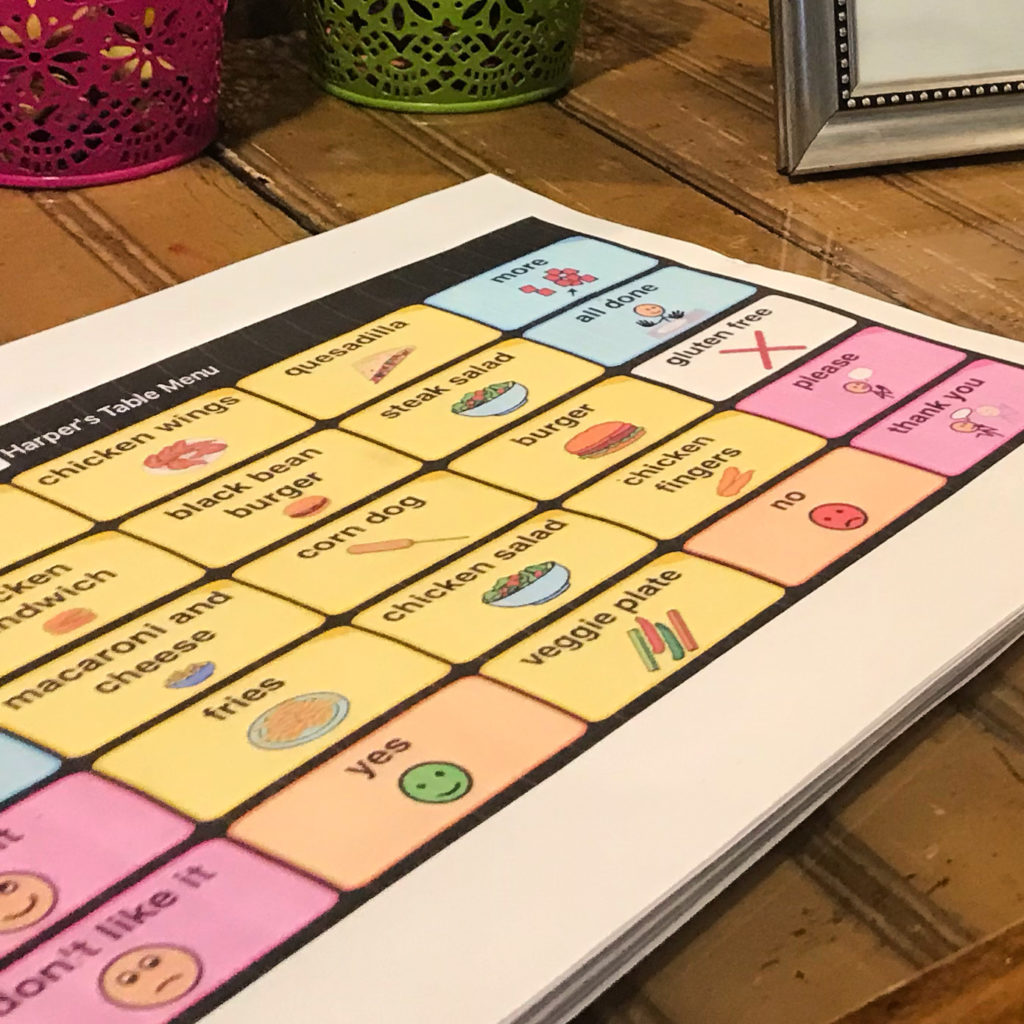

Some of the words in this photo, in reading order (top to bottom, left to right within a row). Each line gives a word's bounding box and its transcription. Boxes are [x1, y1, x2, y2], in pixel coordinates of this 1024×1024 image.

[491, 257, 550, 284] more
[576, 307, 606, 323] all
[605, 283, 659, 310] done
[284, 318, 410, 378] quesadilla
[666, 329, 734, 368] gluten
[727, 307, 773, 330] free
[380, 383, 451, 420] steak
[449, 352, 516, 387] salad
[792, 352, 860, 391] please
[1, 412, 101, 459] Harper's
[97, 389, 160, 417] Table
[157, 365, 221, 394] Menu
[509, 403, 596, 447] burger
[887, 399, 951, 434] thank
[944, 377, 986, 402] you
[37, 432, 156, 487] chicken
[154, 395, 241, 432] wings
[623, 436, 716, 487] chicken
[655, 446, 743, 494] fingers
[164, 480, 254, 521] black
[248, 445, 325, 482] bean
[224, 469, 326, 519] burger
[769, 491, 807, 511] no
[296, 524, 367, 561] corn
[364, 493, 427, 529] dog
[382, 560, 496, 623] chicken
[493, 519, 569, 561] salad
[520, 612, 618, 666] veggie
[613, 569, 683, 613] plate
[3, 622, 169, 711] macaroni
[169, 590, 235, 625] and
[95, 629, 218, 694] cheese
[202, 674, 286, 721] fries
[345, 736, 412, 779] yes
[94, 890, 179, 941] like
[172, 865, 218, 889] it
